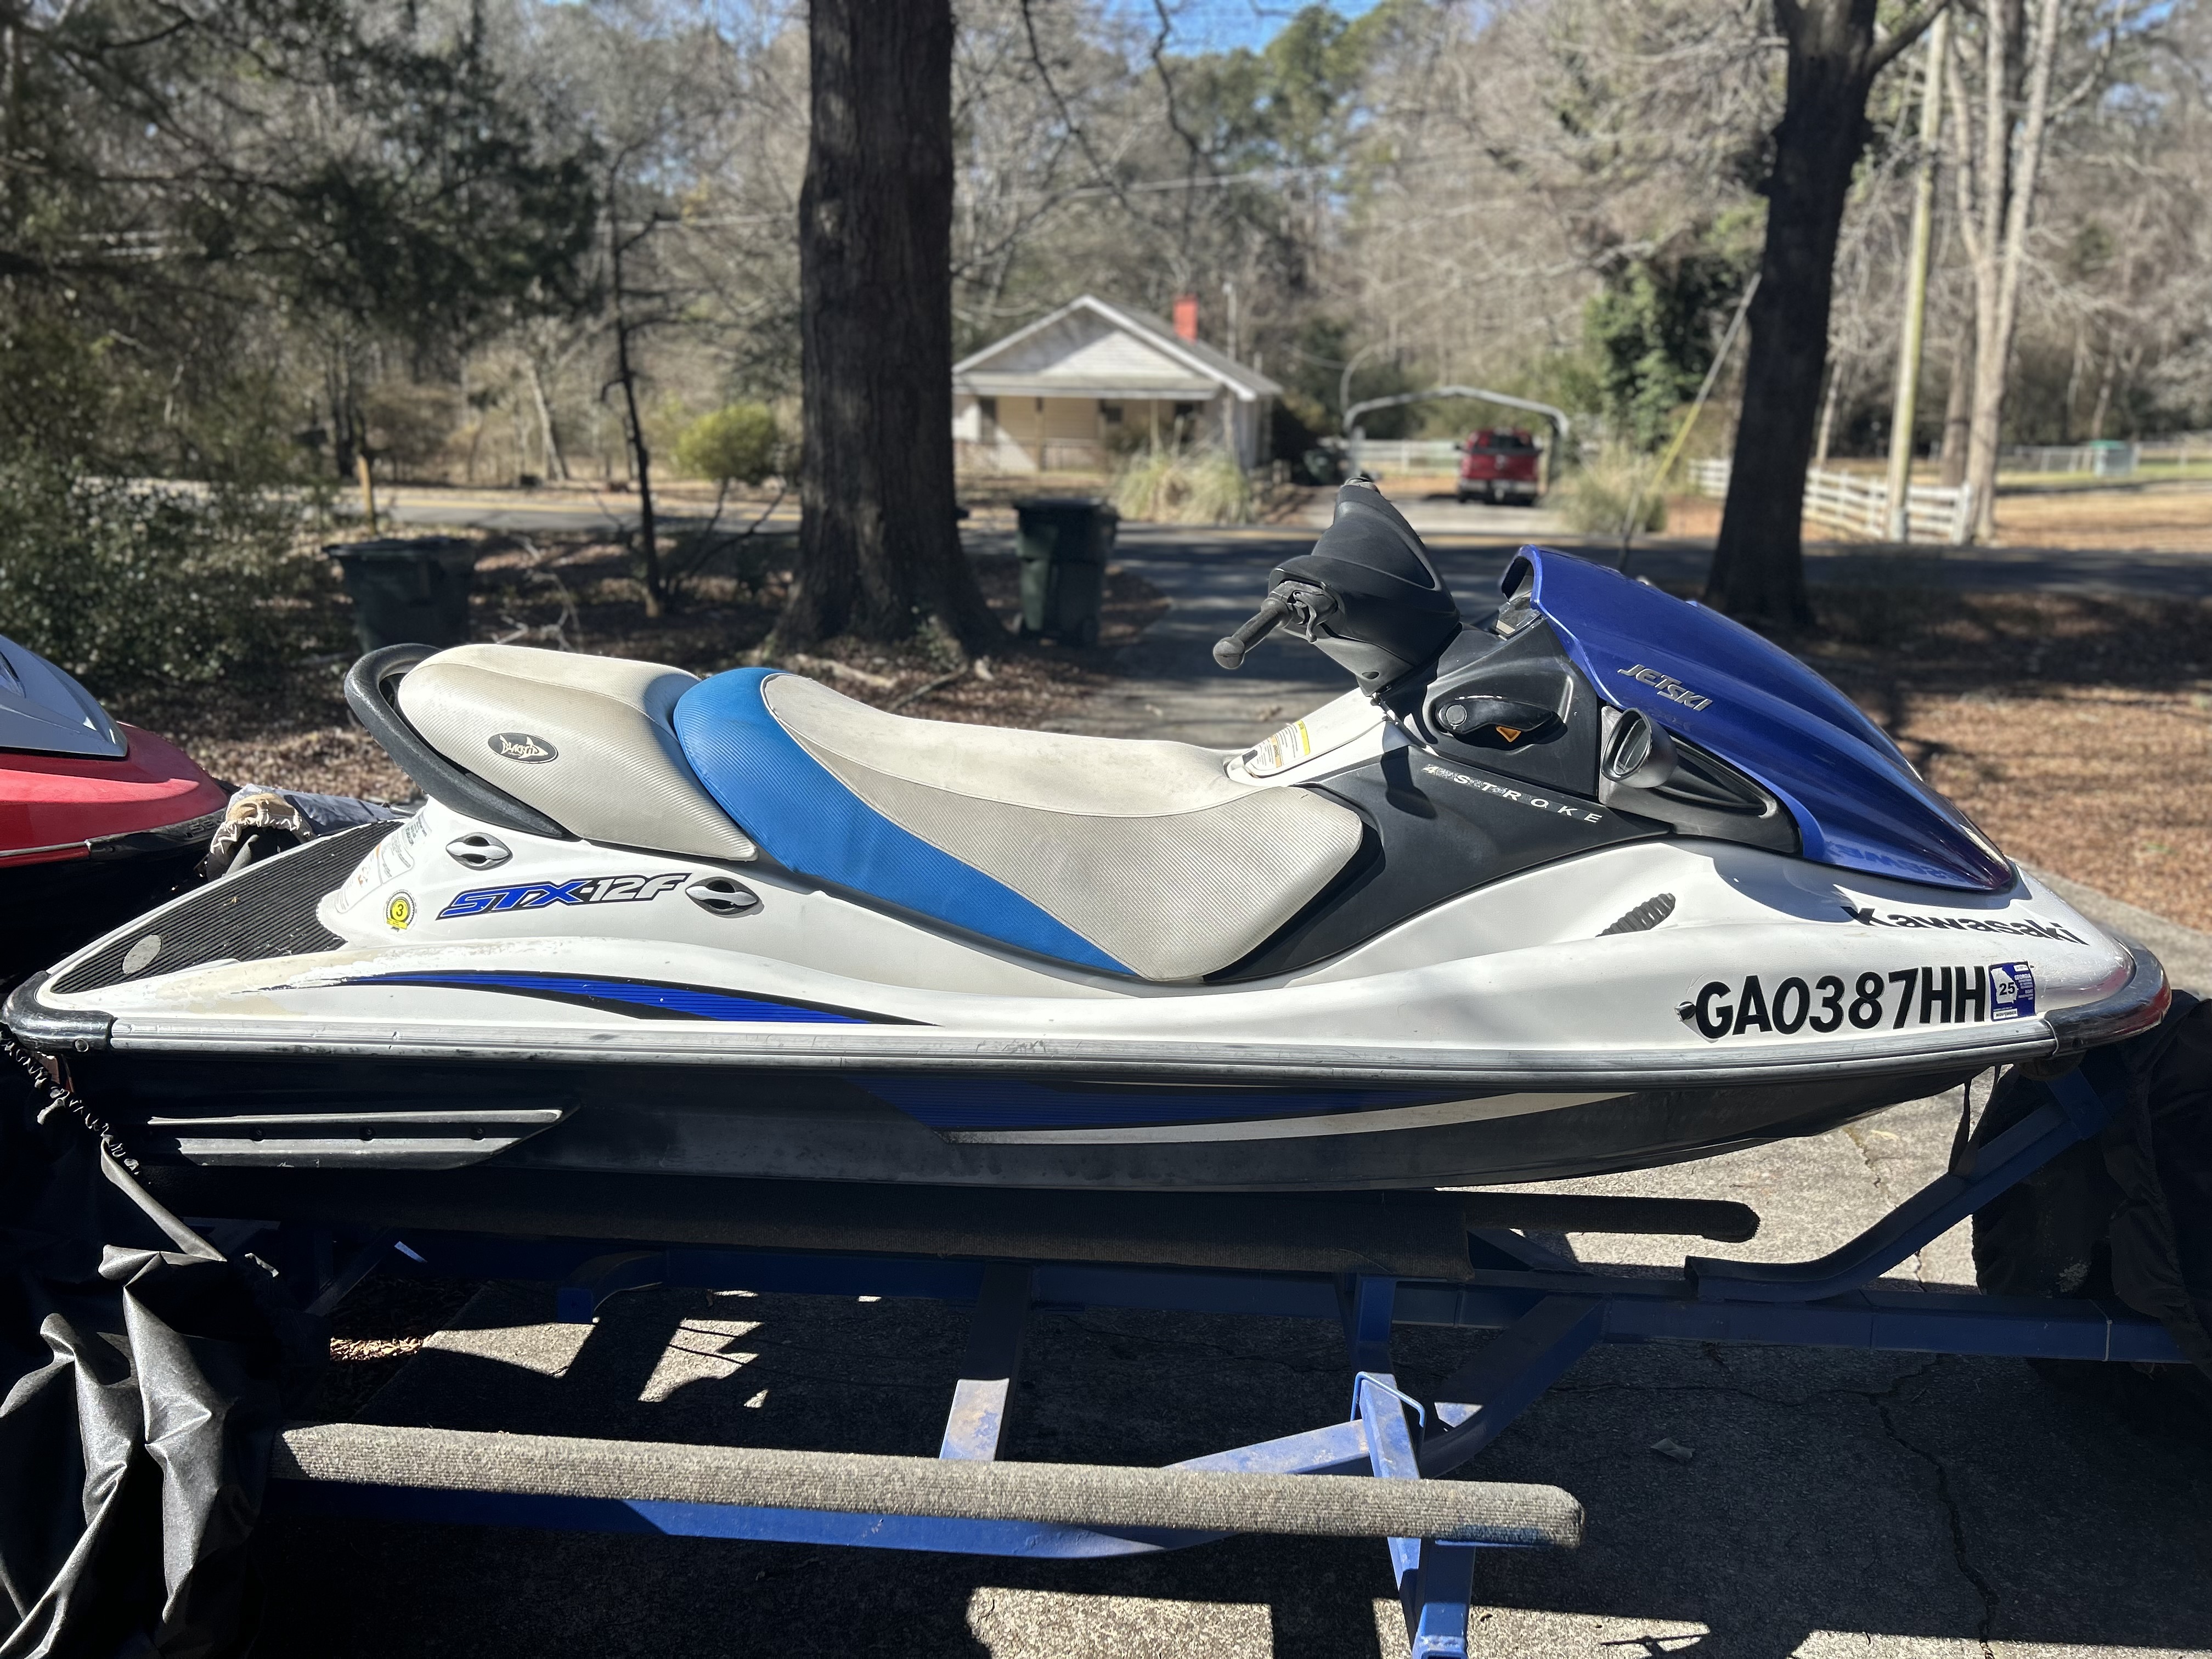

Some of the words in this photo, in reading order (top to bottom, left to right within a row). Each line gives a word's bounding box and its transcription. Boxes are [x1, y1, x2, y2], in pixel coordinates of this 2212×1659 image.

[1453, 774, 1603, 823] STROKE
[396, 904, 404, 917] 3
[436, 873, 692, 921] STX-12F
[1840, 906, 2090, 946] Kawasaki
[1999, 981, 2016, 996] 25
